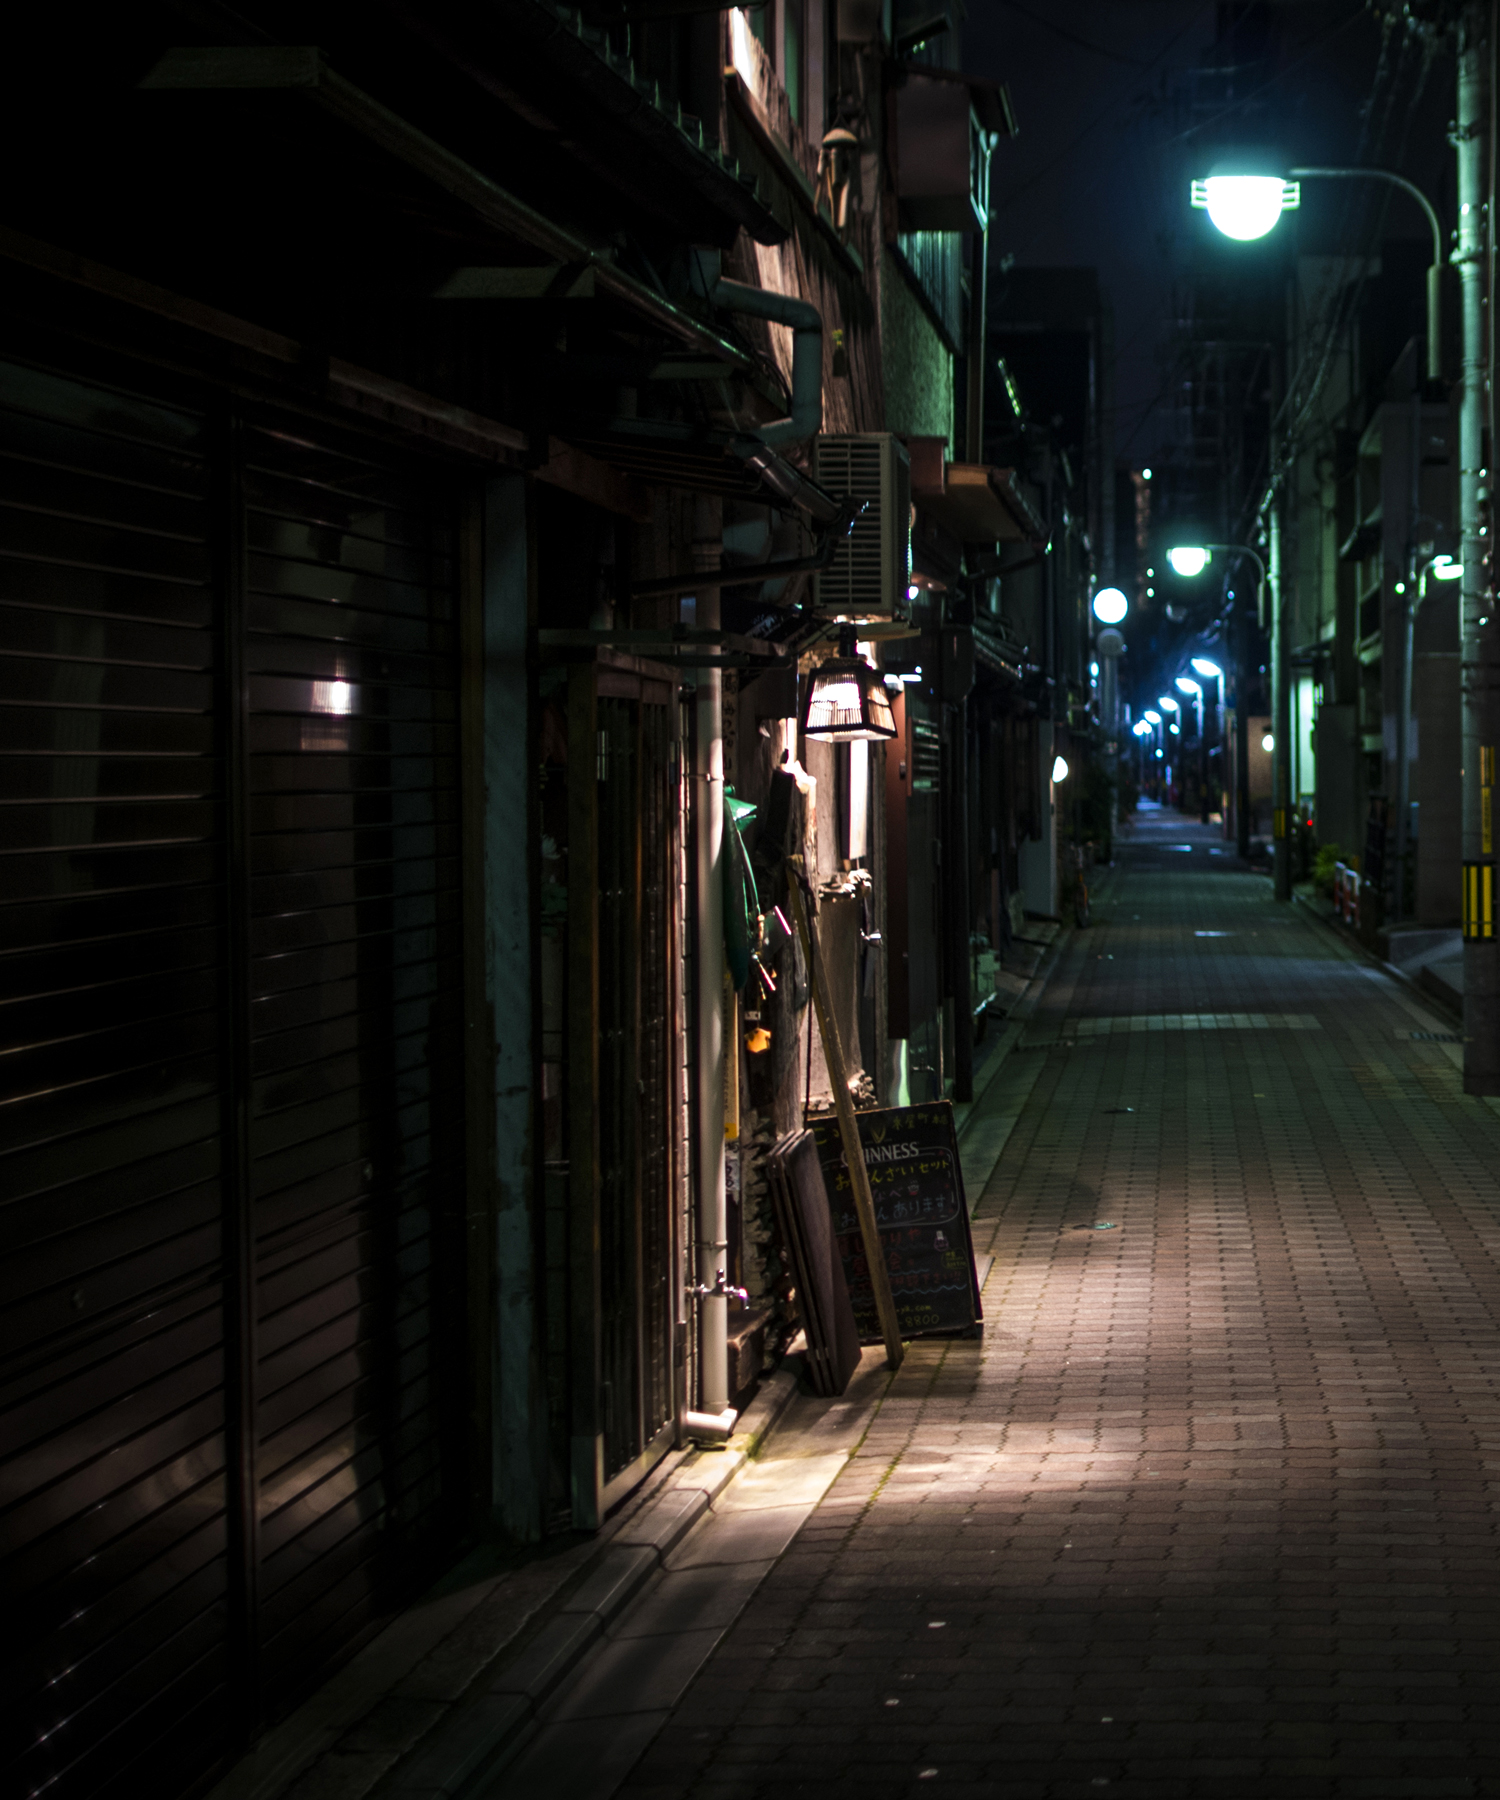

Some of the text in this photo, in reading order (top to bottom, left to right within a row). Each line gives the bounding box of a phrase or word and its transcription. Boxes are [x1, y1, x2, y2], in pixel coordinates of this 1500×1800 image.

[840, 1141, 920, 1166] INNESS
[835, 1158, 949, 1192] おんざいセット
[841, 1193, 946, 1229] おんあります
